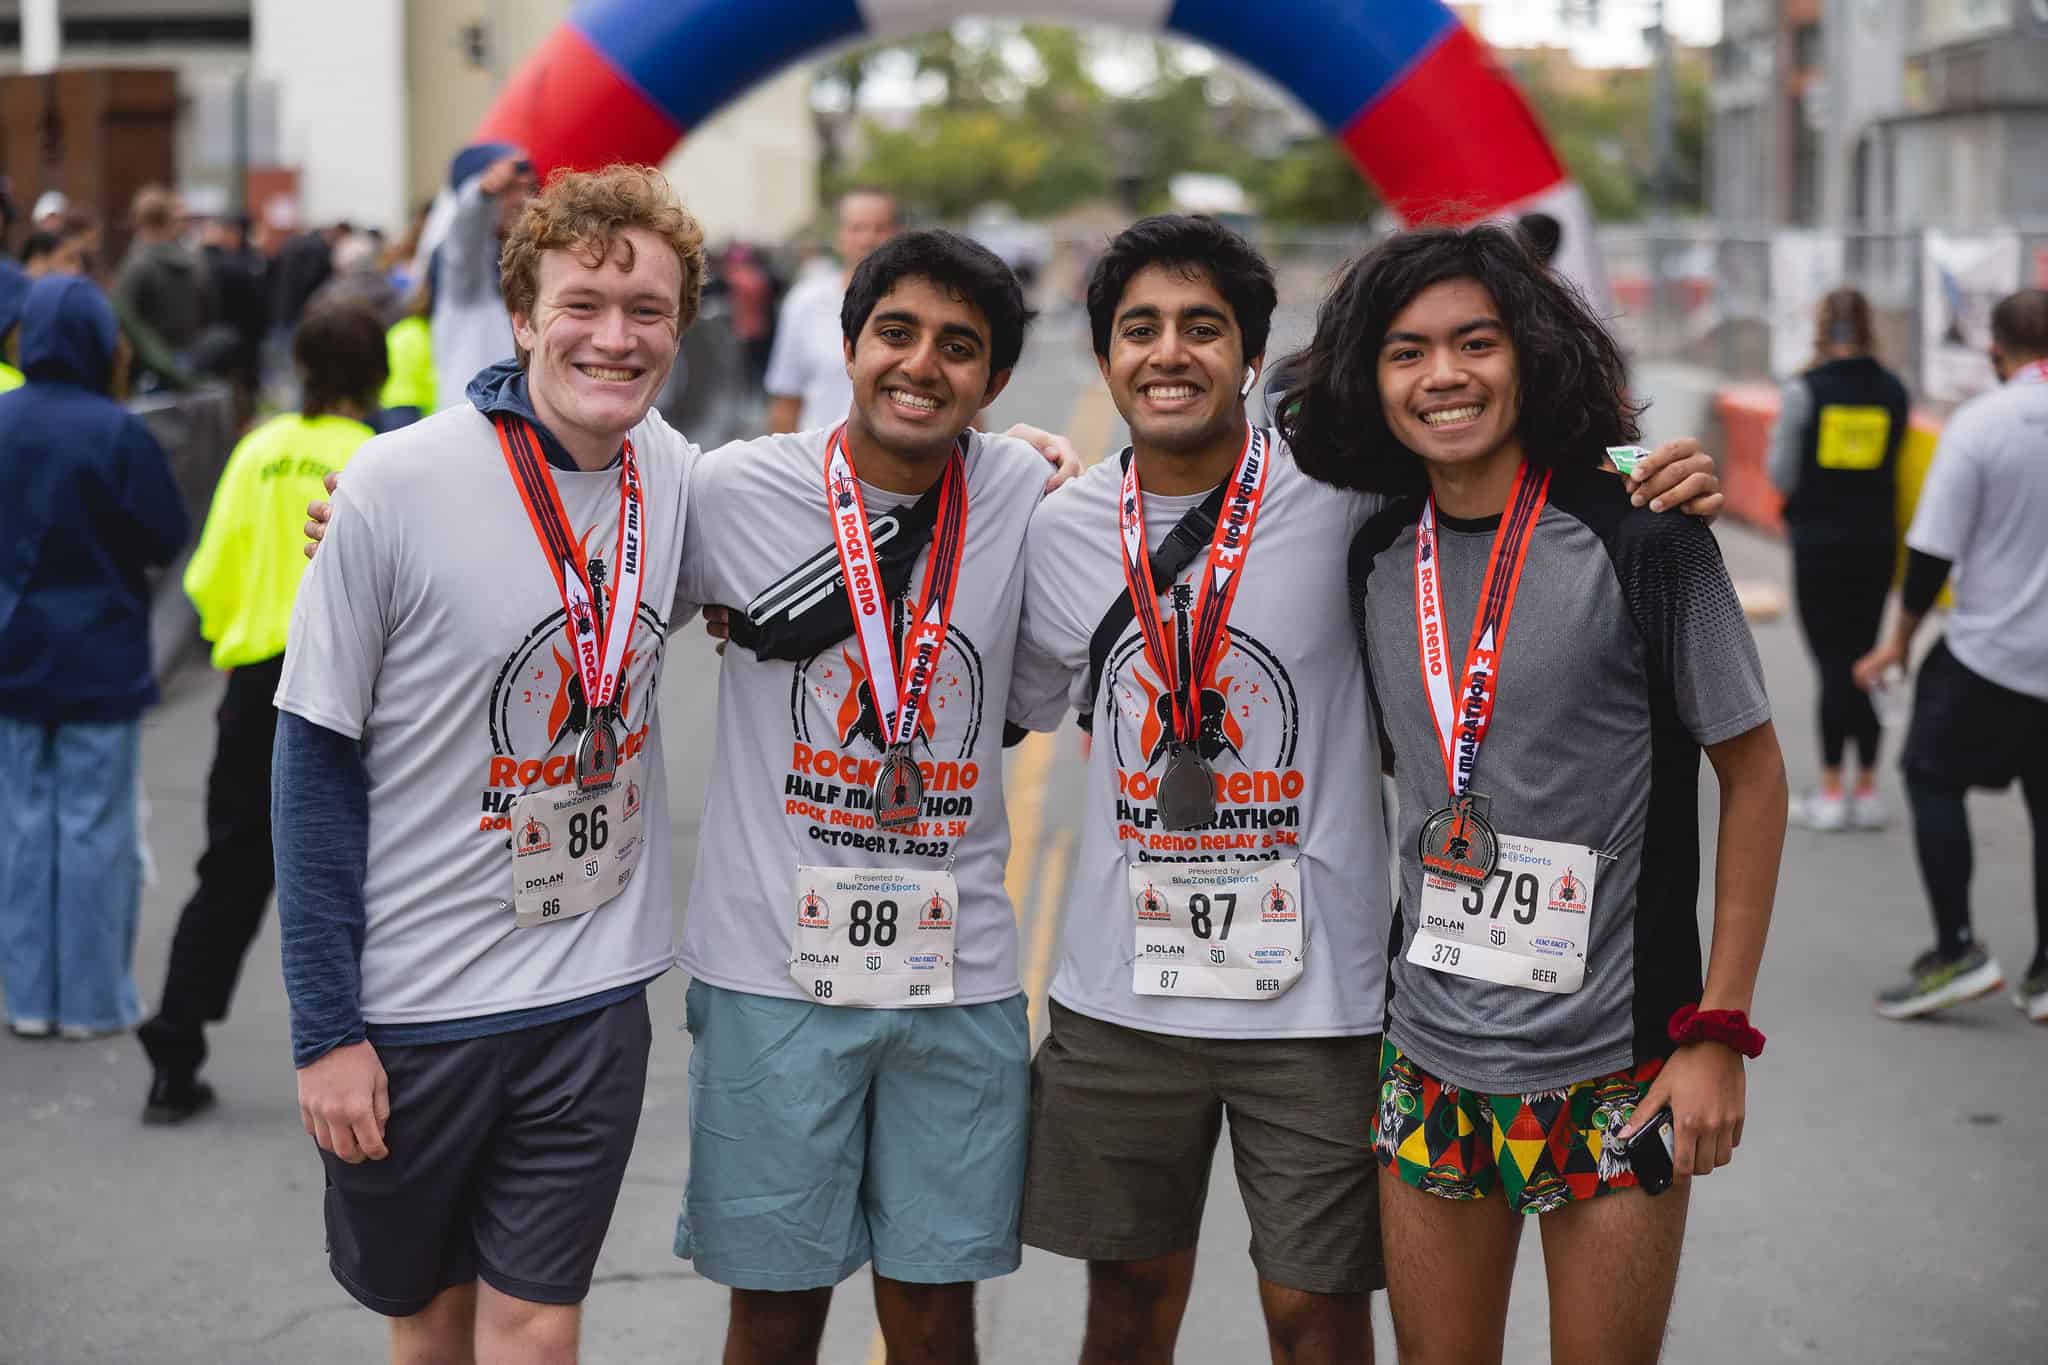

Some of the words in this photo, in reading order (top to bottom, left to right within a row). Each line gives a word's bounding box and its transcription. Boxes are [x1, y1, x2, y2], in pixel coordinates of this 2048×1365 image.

[841, 512, 865, 562] ROCK
[625, 532, 638, 575] HALF
[1421, 567, 1436, 618] ROCK
[792, 742, 881, 790] ROCK
[915, 761, 980, 791] eno
[785, 774, 841, 804] HALF
[785, 799, 826, 826] ROCK
[933, 822, 945, 837] &
[947, 820, 968, 838] 5K
[568, 804, 608, 859] 86
[1275, 830, 1297, 846] 5K
[903, 840, 949, 858] 2023
[1523, 843, 1534, 853] by
[526, 872, 564, 889] DOLAN
[854, 874, 892, 882] Presented
[894, 874, 904, 883] by
[1188, 867, 1228, 875] Presented
[1230, 867, 1241, 877] by
[1462, 869, 1540, 925] 379
[542, 898, 560, 917] 86
[1188, 893, 1237, 941] 87
[849, 899, 898, 947] 88
[1427, 915, 1465, 931] DOLAN
[800, 952, 839, 964] DOLAN
[1146, 944, 1185, 954] DOLAN
[1432, 943, 1461, 966] 379
[1160, 970, 1178, 989] 87
[1256, 979, 1280, 991] BEER
[1531, 968, 1557, 984] BEER
[815, 979, 832, 998] 88
[909, 984, 930, 996] BEER
